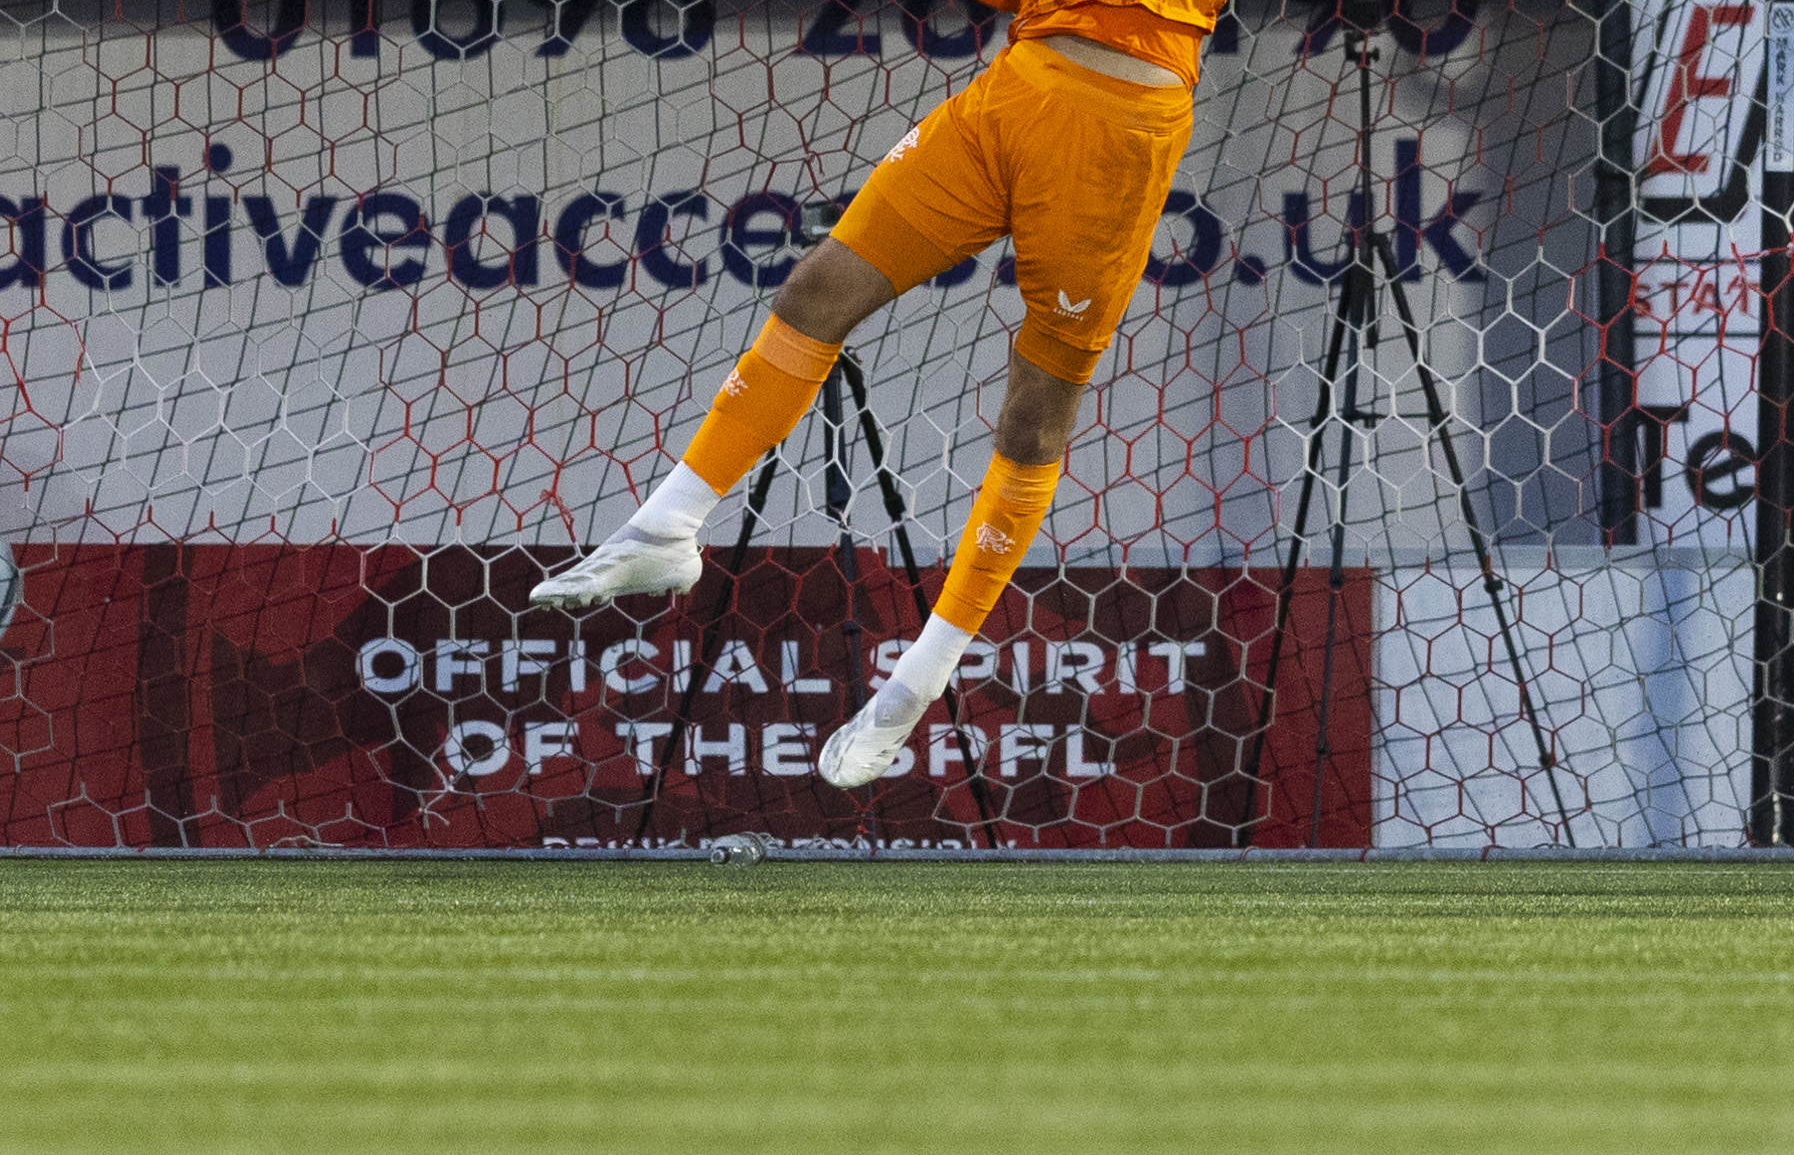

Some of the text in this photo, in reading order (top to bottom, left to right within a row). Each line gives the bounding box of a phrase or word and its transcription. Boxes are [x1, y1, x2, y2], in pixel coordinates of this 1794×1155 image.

[356, 637, 832, 694] OFFICIAL
[444, 721, 581, 777] OF
[616, 722, 817, 777] THE
